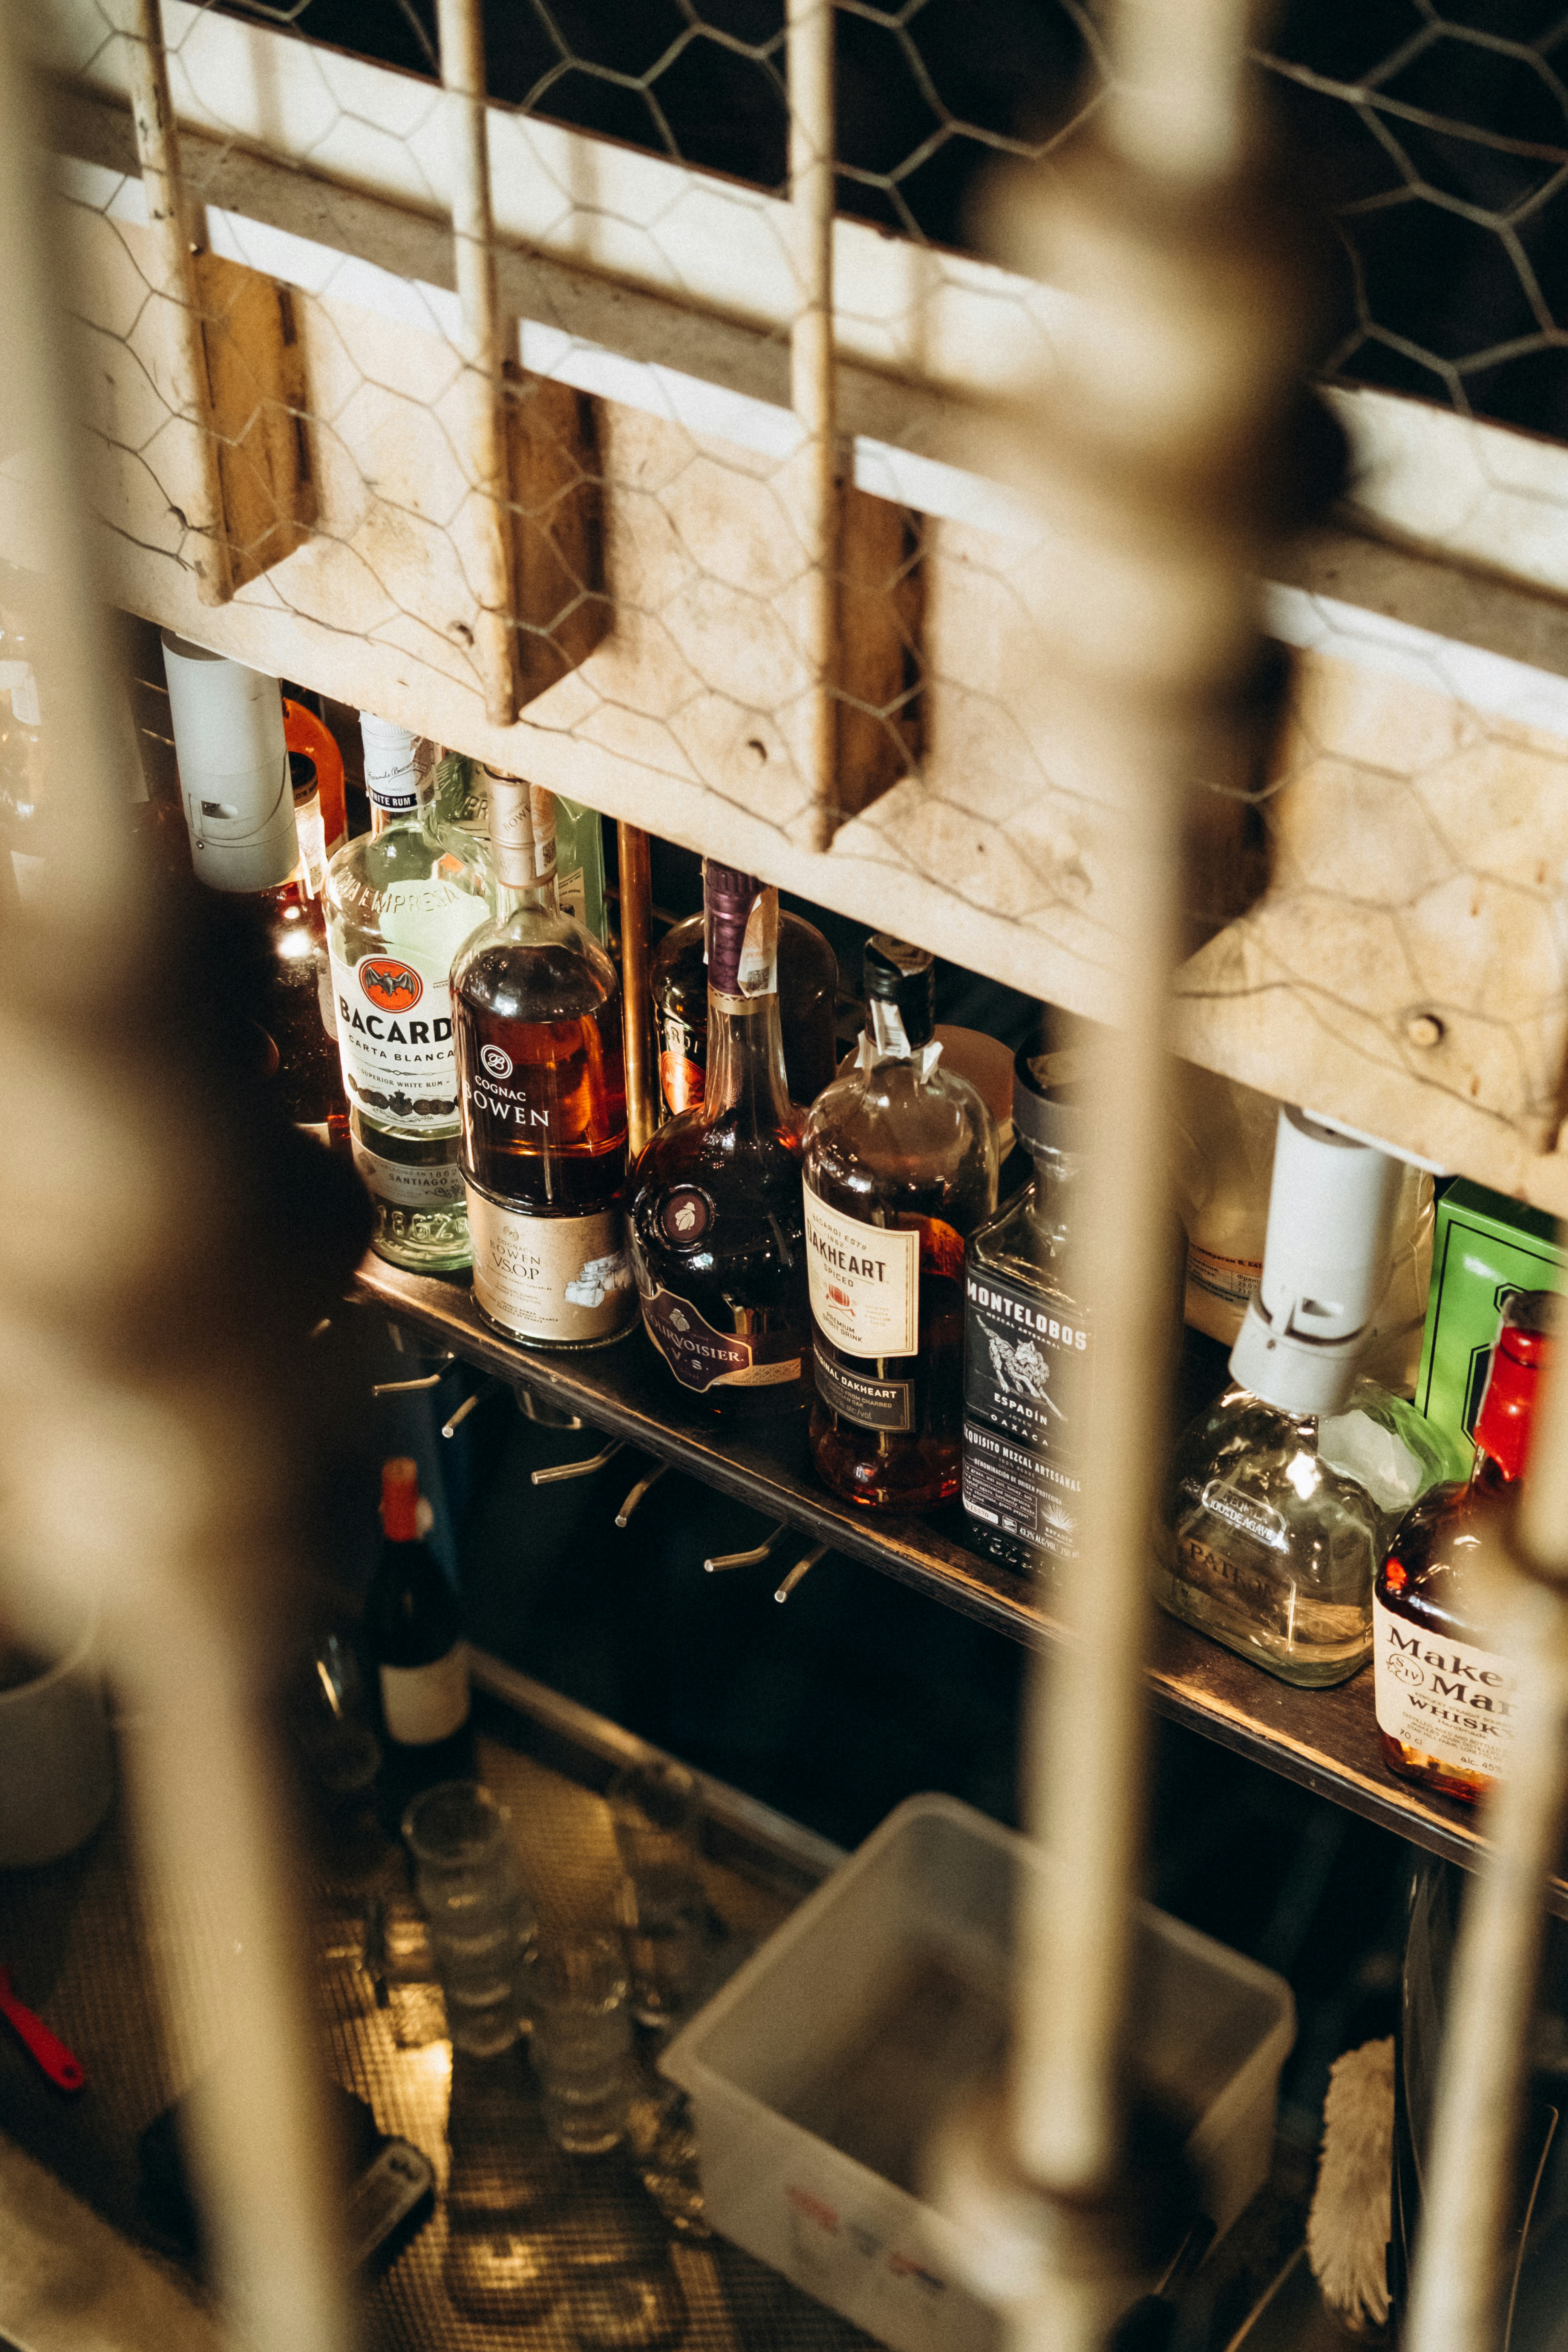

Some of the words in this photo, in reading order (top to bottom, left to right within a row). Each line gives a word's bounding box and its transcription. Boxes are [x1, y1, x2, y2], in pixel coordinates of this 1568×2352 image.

[369, 788, 390, 805] WHITE
[392, 797, 410, 806] RUM
[349, 1035, 387, 1058] CARTA
[394, 1050, 454, 1062] BLANCA
[361, 1069, 394, 1086] SUPERIOR
[475, 1075, 526, 1101] COGNAC
[462, 1079, 549, 1127] BOWEN
[389, 1173, 447, 1186] SANTIAGO
[429, 1168, 457, 1179] 1862
[490, 1239, 541, 1265] BOWEN
[807, 1217, 886, 1282] OAKHEART
[824, 1263, 854, 1288] SPICED
[826, 1311, 855, 1334] PREMIUM
[967, 1277, 1087, 1351] MONTELOBOS
[822, 1313, 840, 1331] SPIRIT
[841, 1327, 862, 1343] DRINK
[986, 1311, 1015, 1329] MEZCAL
[1018, 1326, 1060, 1350] ARTESANAL
[841, 1376, 897, 1399] OAKHEART
[845, 1391, 861, 1401] FROM
[862, 1398, 892, 1408] CHARRED
[994, 1392, 1047, 1426] ESPADÍN
[991, 1413, 1048, 1447] OAXACA
[1008, 1413, 1032, 1428] JOVEN
[1003, 1446, 1032, 1469] MEZCAL
[1035, 1462, 1081, 1492] ARTESANAL
[974, 1458, 1010, 1480] DENOMINACIÓN
[1011, 1475, 1017, 1484] DE
[1018, 1479, 1035, 1493] ORIGEN
[1036, 1488, 1062, 1505] PROTEGIDA
[972, 1494, 985, 1503] wood
[998, 1501, 1012, 1511] green
[1004, 1492, 1031, 1508] integration
[1230, 1509, 1244, 1524] DE
[1019, 1527, 1035, 1540] 43.2%
[1415, 1692, 1447, 1708] KENTUCKY
[1449, 1705, 1480, 1720] STRAIGHT
[1400, 1729, 1411, 1740] 70
[1407, 1724, 1422, 1733] STAR
[1423, 1732, 1436, 1740] HILL
[1435, 1726, 1453, 1736] AGED
[1470, 1739, 1501, 1752] BOTTLED
[1438, 1718, 1488, 1740] Handmade
[1441, 1734, 1461, 1744] MARK
[1461, 1756, 1479, 1767] alc.
[1482, 1761, 1503, 1773] 45%
